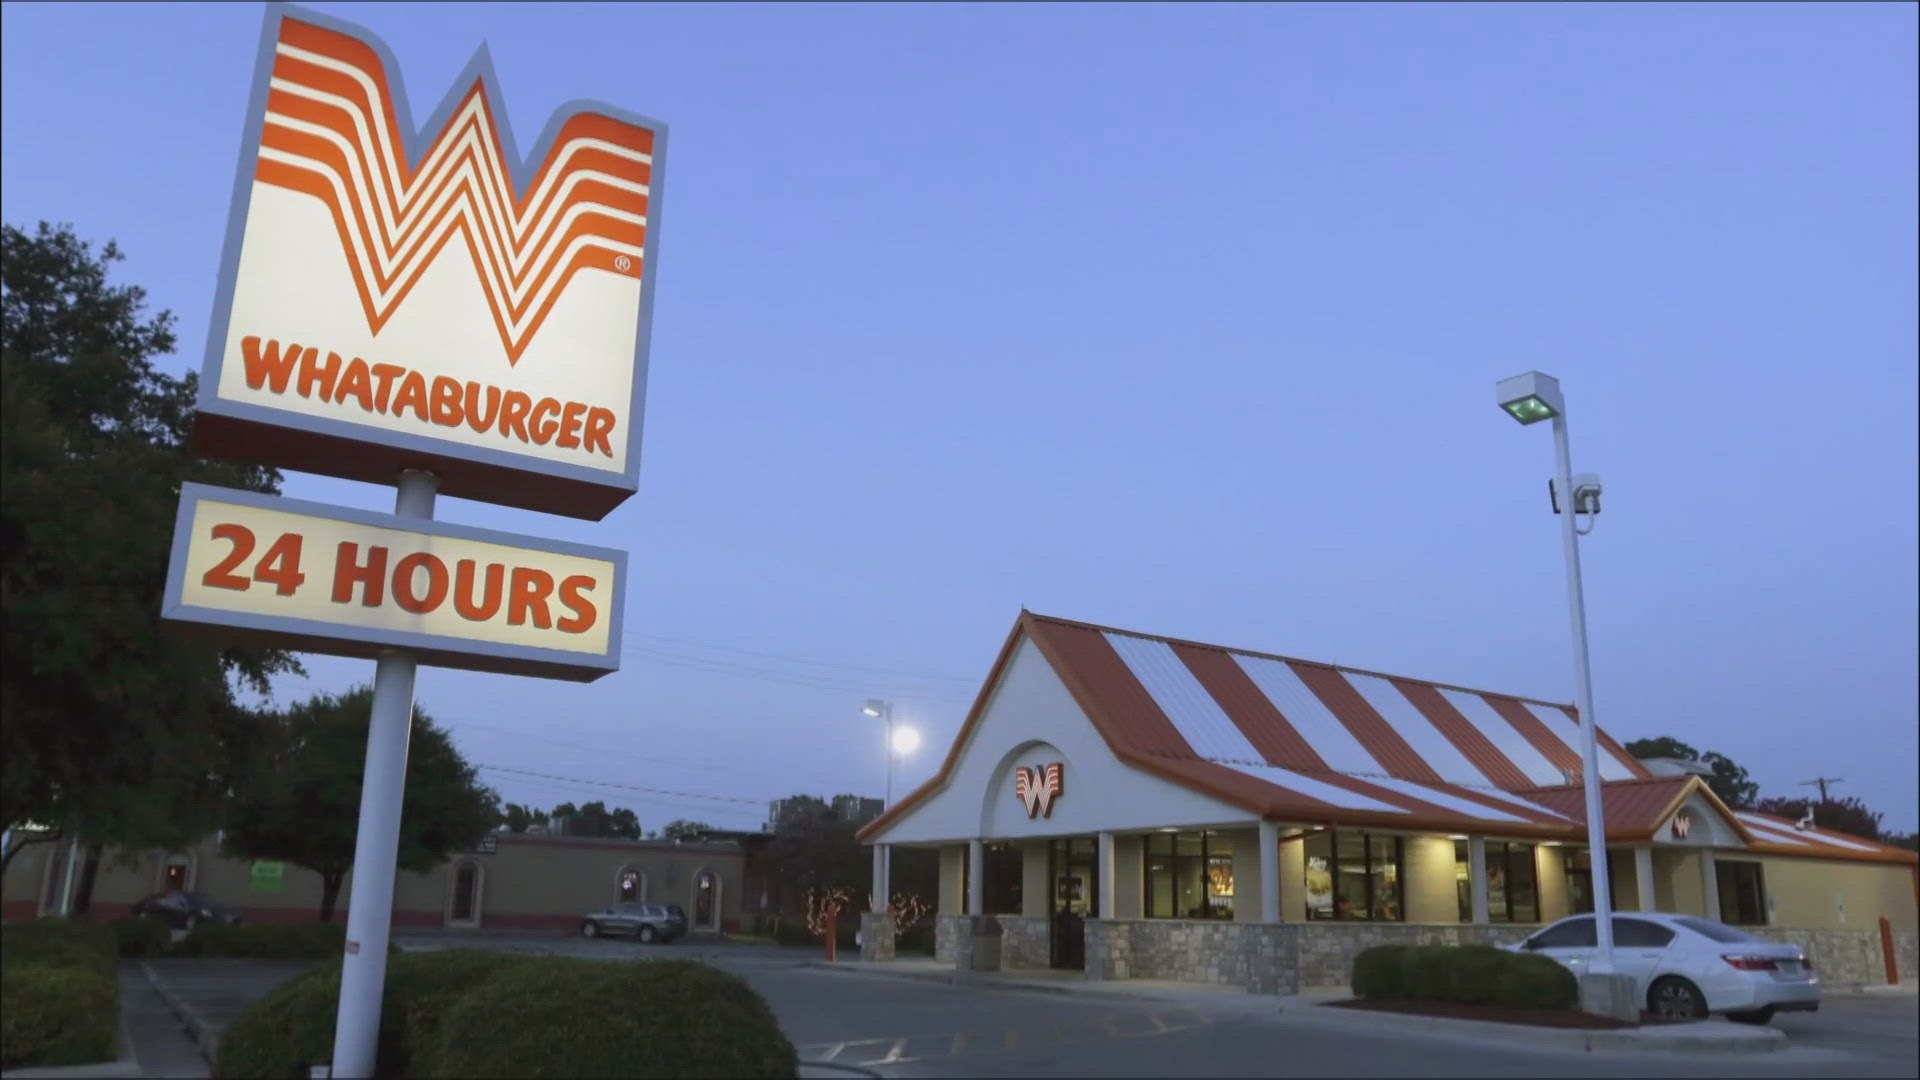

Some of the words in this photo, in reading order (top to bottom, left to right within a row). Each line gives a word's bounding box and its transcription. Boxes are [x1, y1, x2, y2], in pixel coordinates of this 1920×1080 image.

[254, 15, 654, 367] W
[241, 335, 616, 458] WHATABURGER
[202, 523, 305, 596] 24
[331, 541, 597, 633] HOURS
[1016, 762, 1064, 820] W
